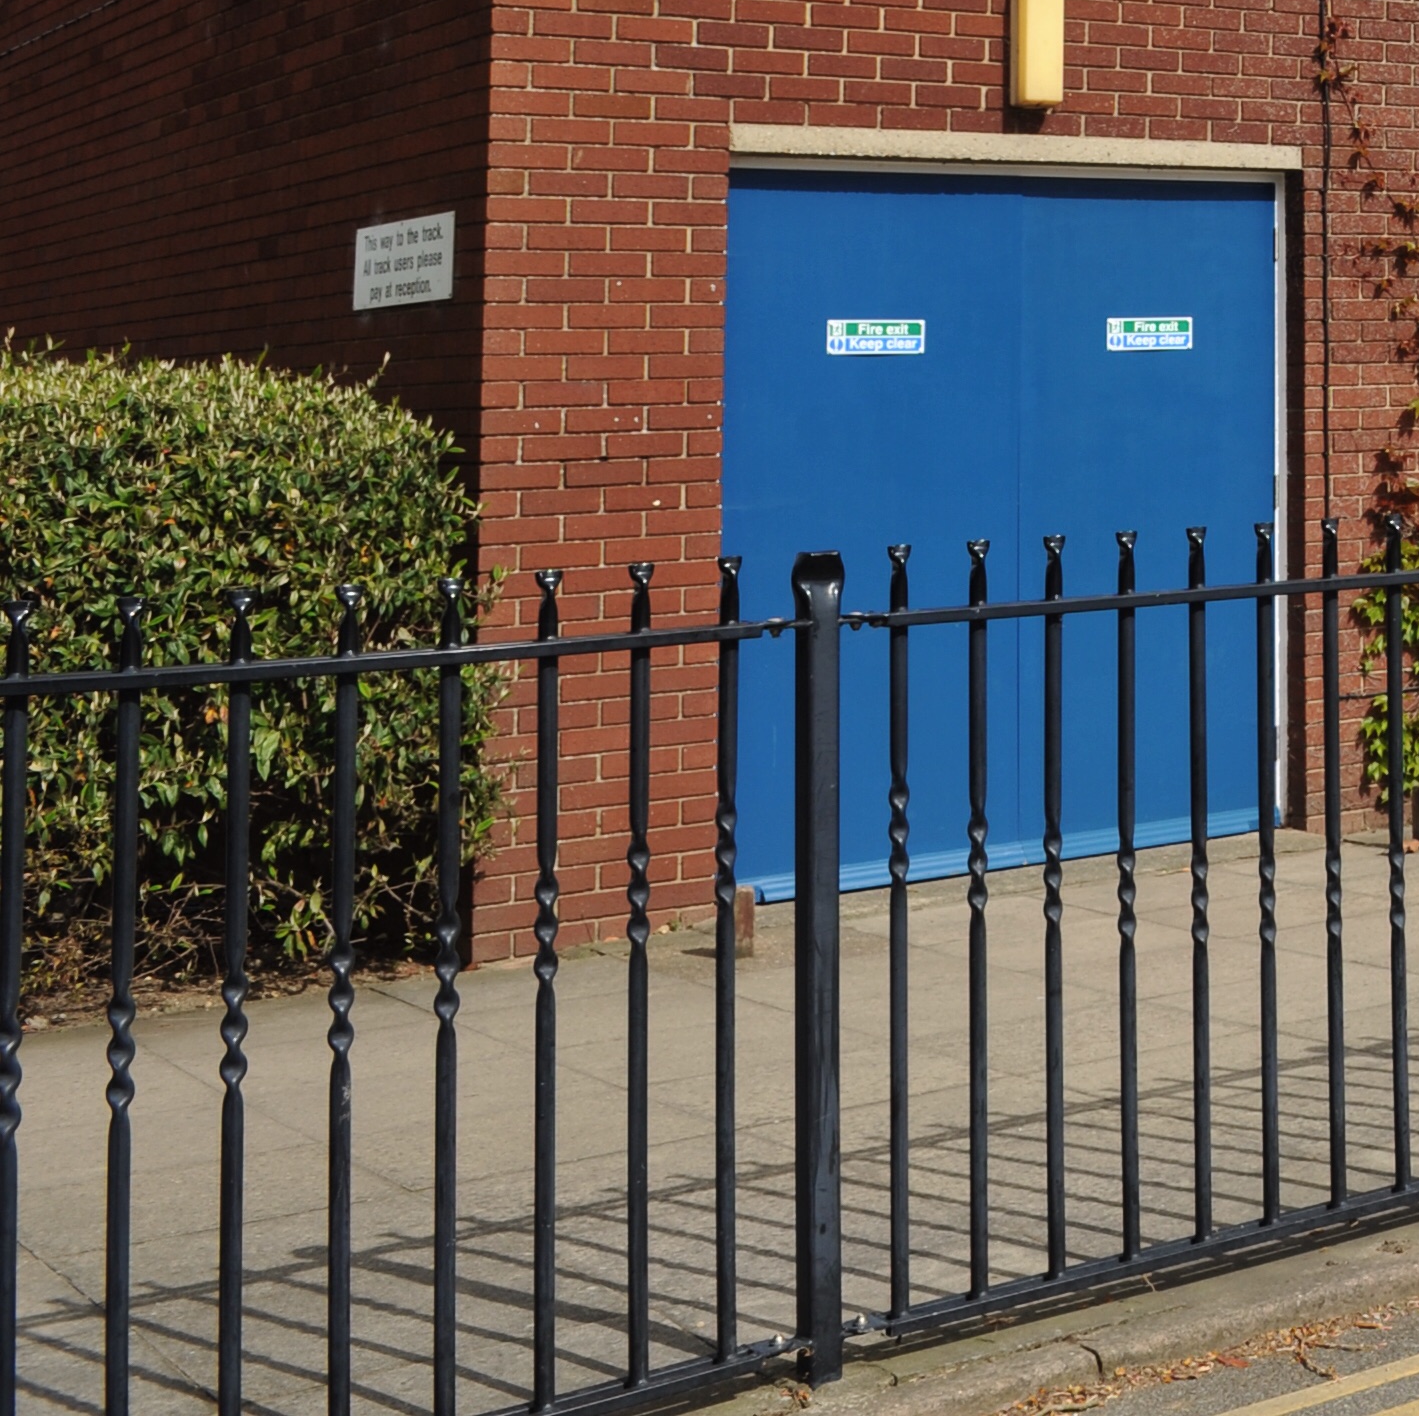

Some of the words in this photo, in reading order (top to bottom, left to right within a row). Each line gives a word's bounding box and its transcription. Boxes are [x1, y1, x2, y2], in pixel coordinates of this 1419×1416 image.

[365, 236, 377, 252] This
[380, 236, 394, 251] way
[396, 231, 404, 246] to
[407, 228, 418, 245] the
[363, 259, 371, 276] All
[374, 257, 391, 274] track
[394, 256, 414, 271] users
[417, 251, 442, 272] please
[369, 286, 382, 303] pay
[385, 283, 392, 298] at
[858, 324, 883, 335] Fire
[886, 323, 909, 335] exit
[1134, 322, 1156, 332] Fire
[1159, 321, 1179, 332] exit
[849, 338, 883, 351] Keep
[886, 338, 917, 349] clear
[1126, 335, 1157, 347] Keep
[1159, 335, 1187, 345] clear
